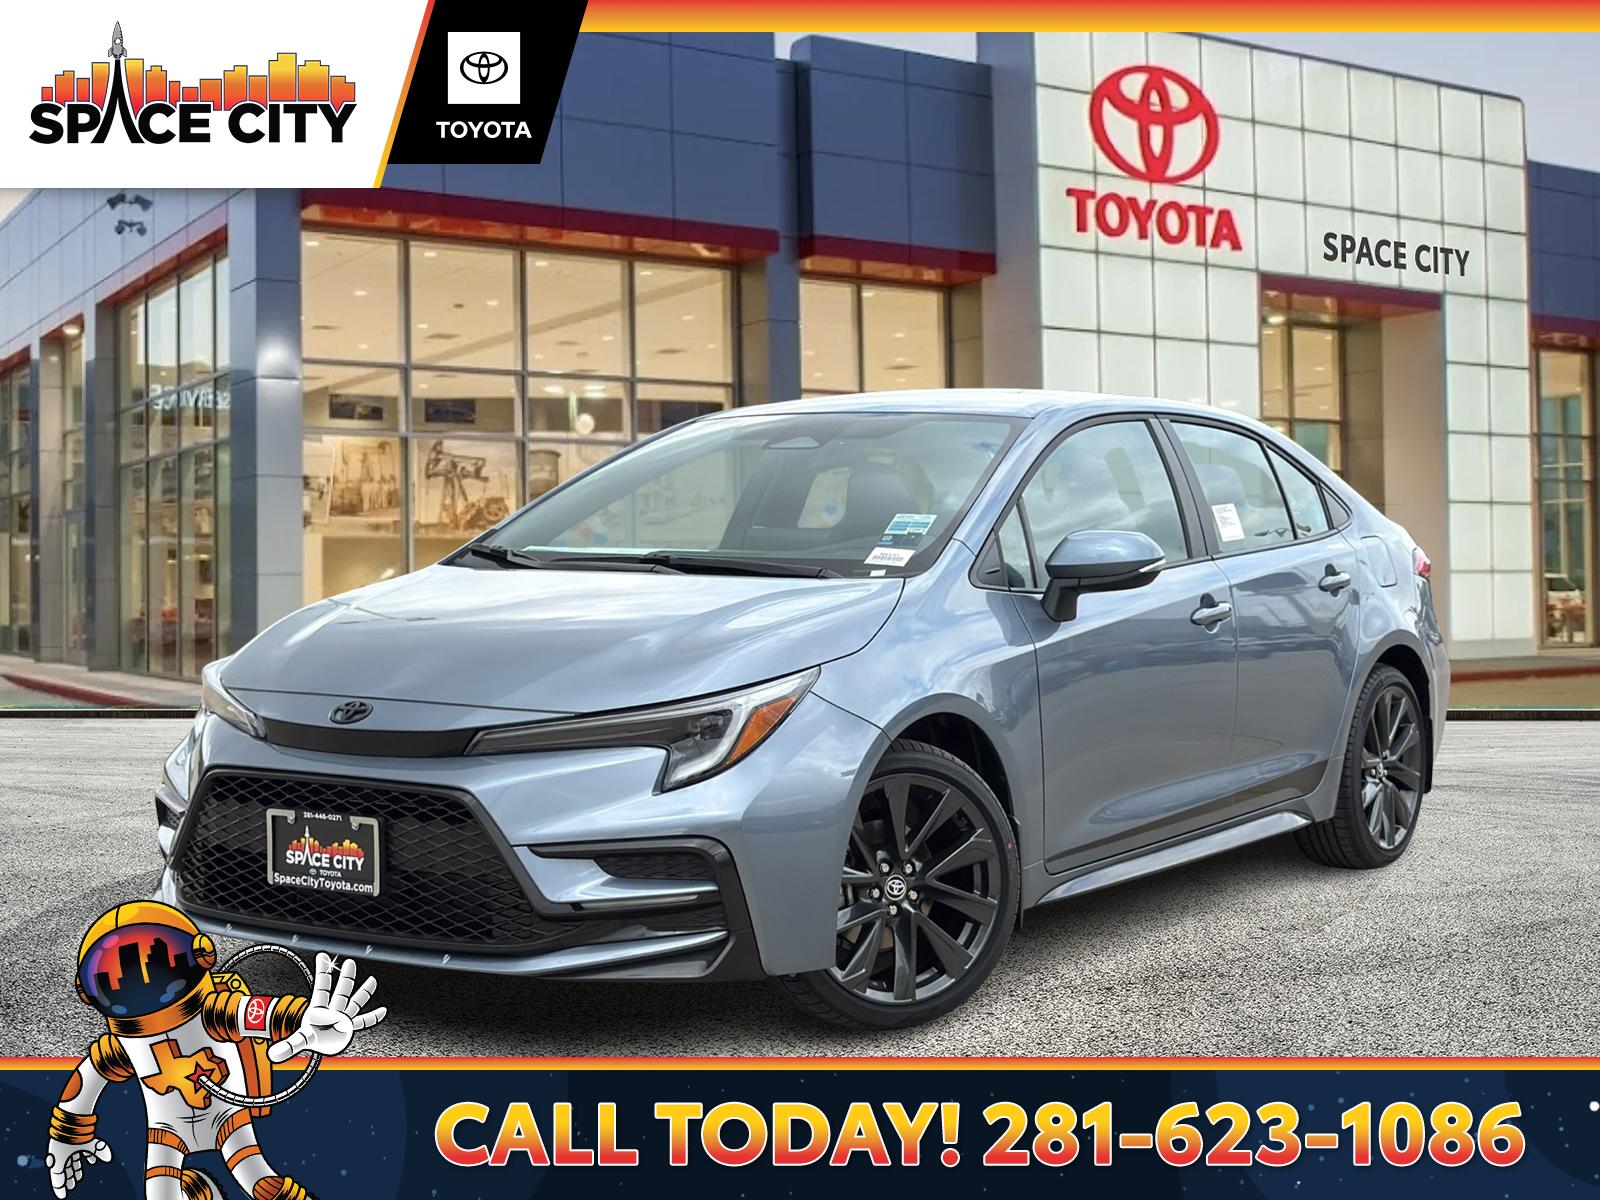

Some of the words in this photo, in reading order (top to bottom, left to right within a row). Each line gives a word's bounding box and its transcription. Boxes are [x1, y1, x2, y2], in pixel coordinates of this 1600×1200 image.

[1065, 187, 1243, 251] TOYOTA
[1323, 232, 1407, 270] SPACE
[1414, 244, 1470, 277] CITY
[286, 850, 330, 868] SPACE
[333, 855, 364, 871] CITY
[274, 872, 373, 893] SpaceCityToyota.com
[319, 869, 342, 878] TOYOTA
